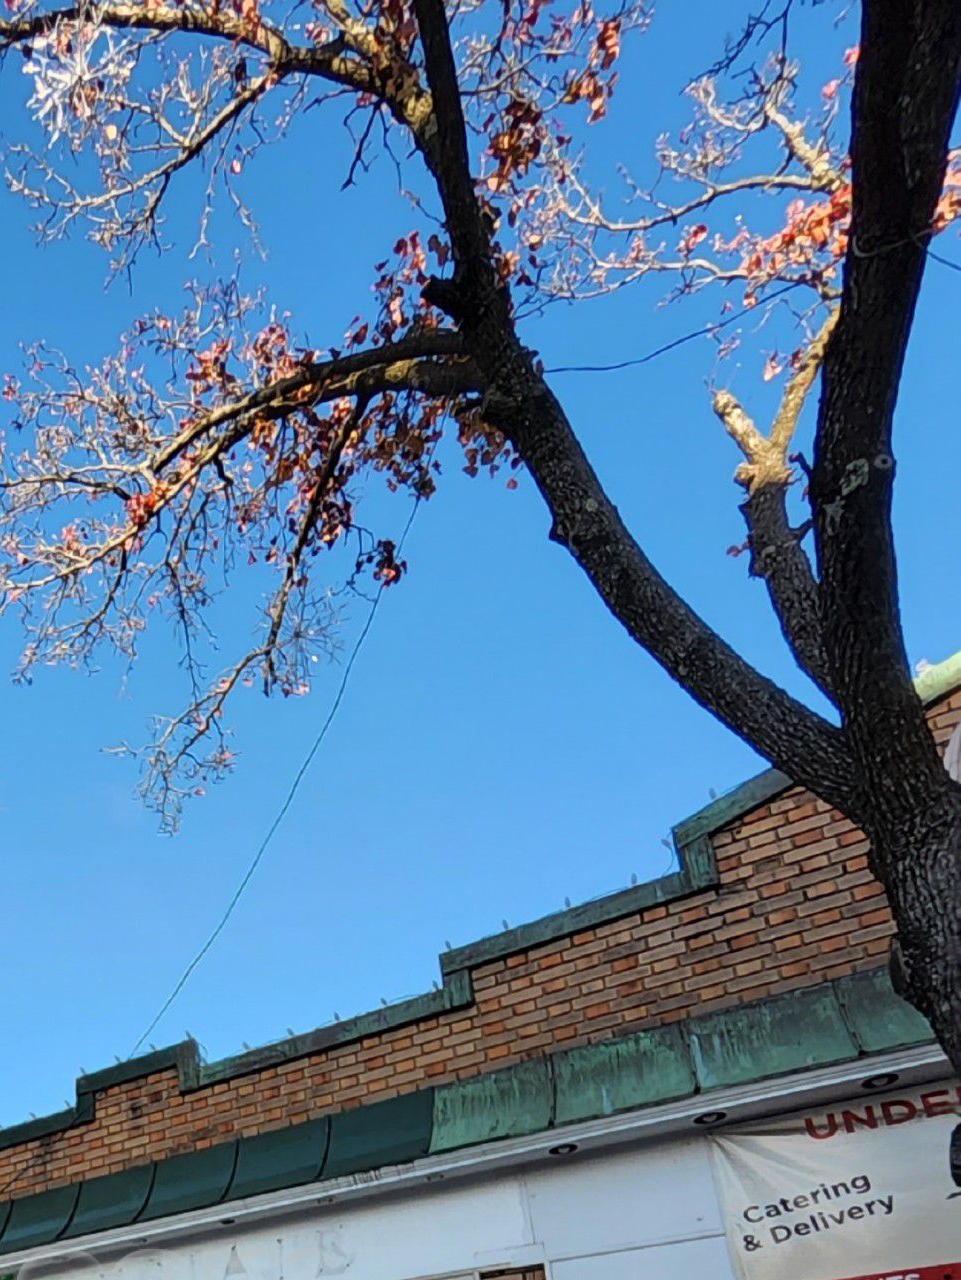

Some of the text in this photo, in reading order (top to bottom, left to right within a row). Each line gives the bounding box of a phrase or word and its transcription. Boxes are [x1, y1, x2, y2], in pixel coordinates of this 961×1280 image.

[804, 1086, 961, 1140] UNDE
[742, 1195, 893, 1252] & Delivery
[743, 1174, 871, 1223] Catering
